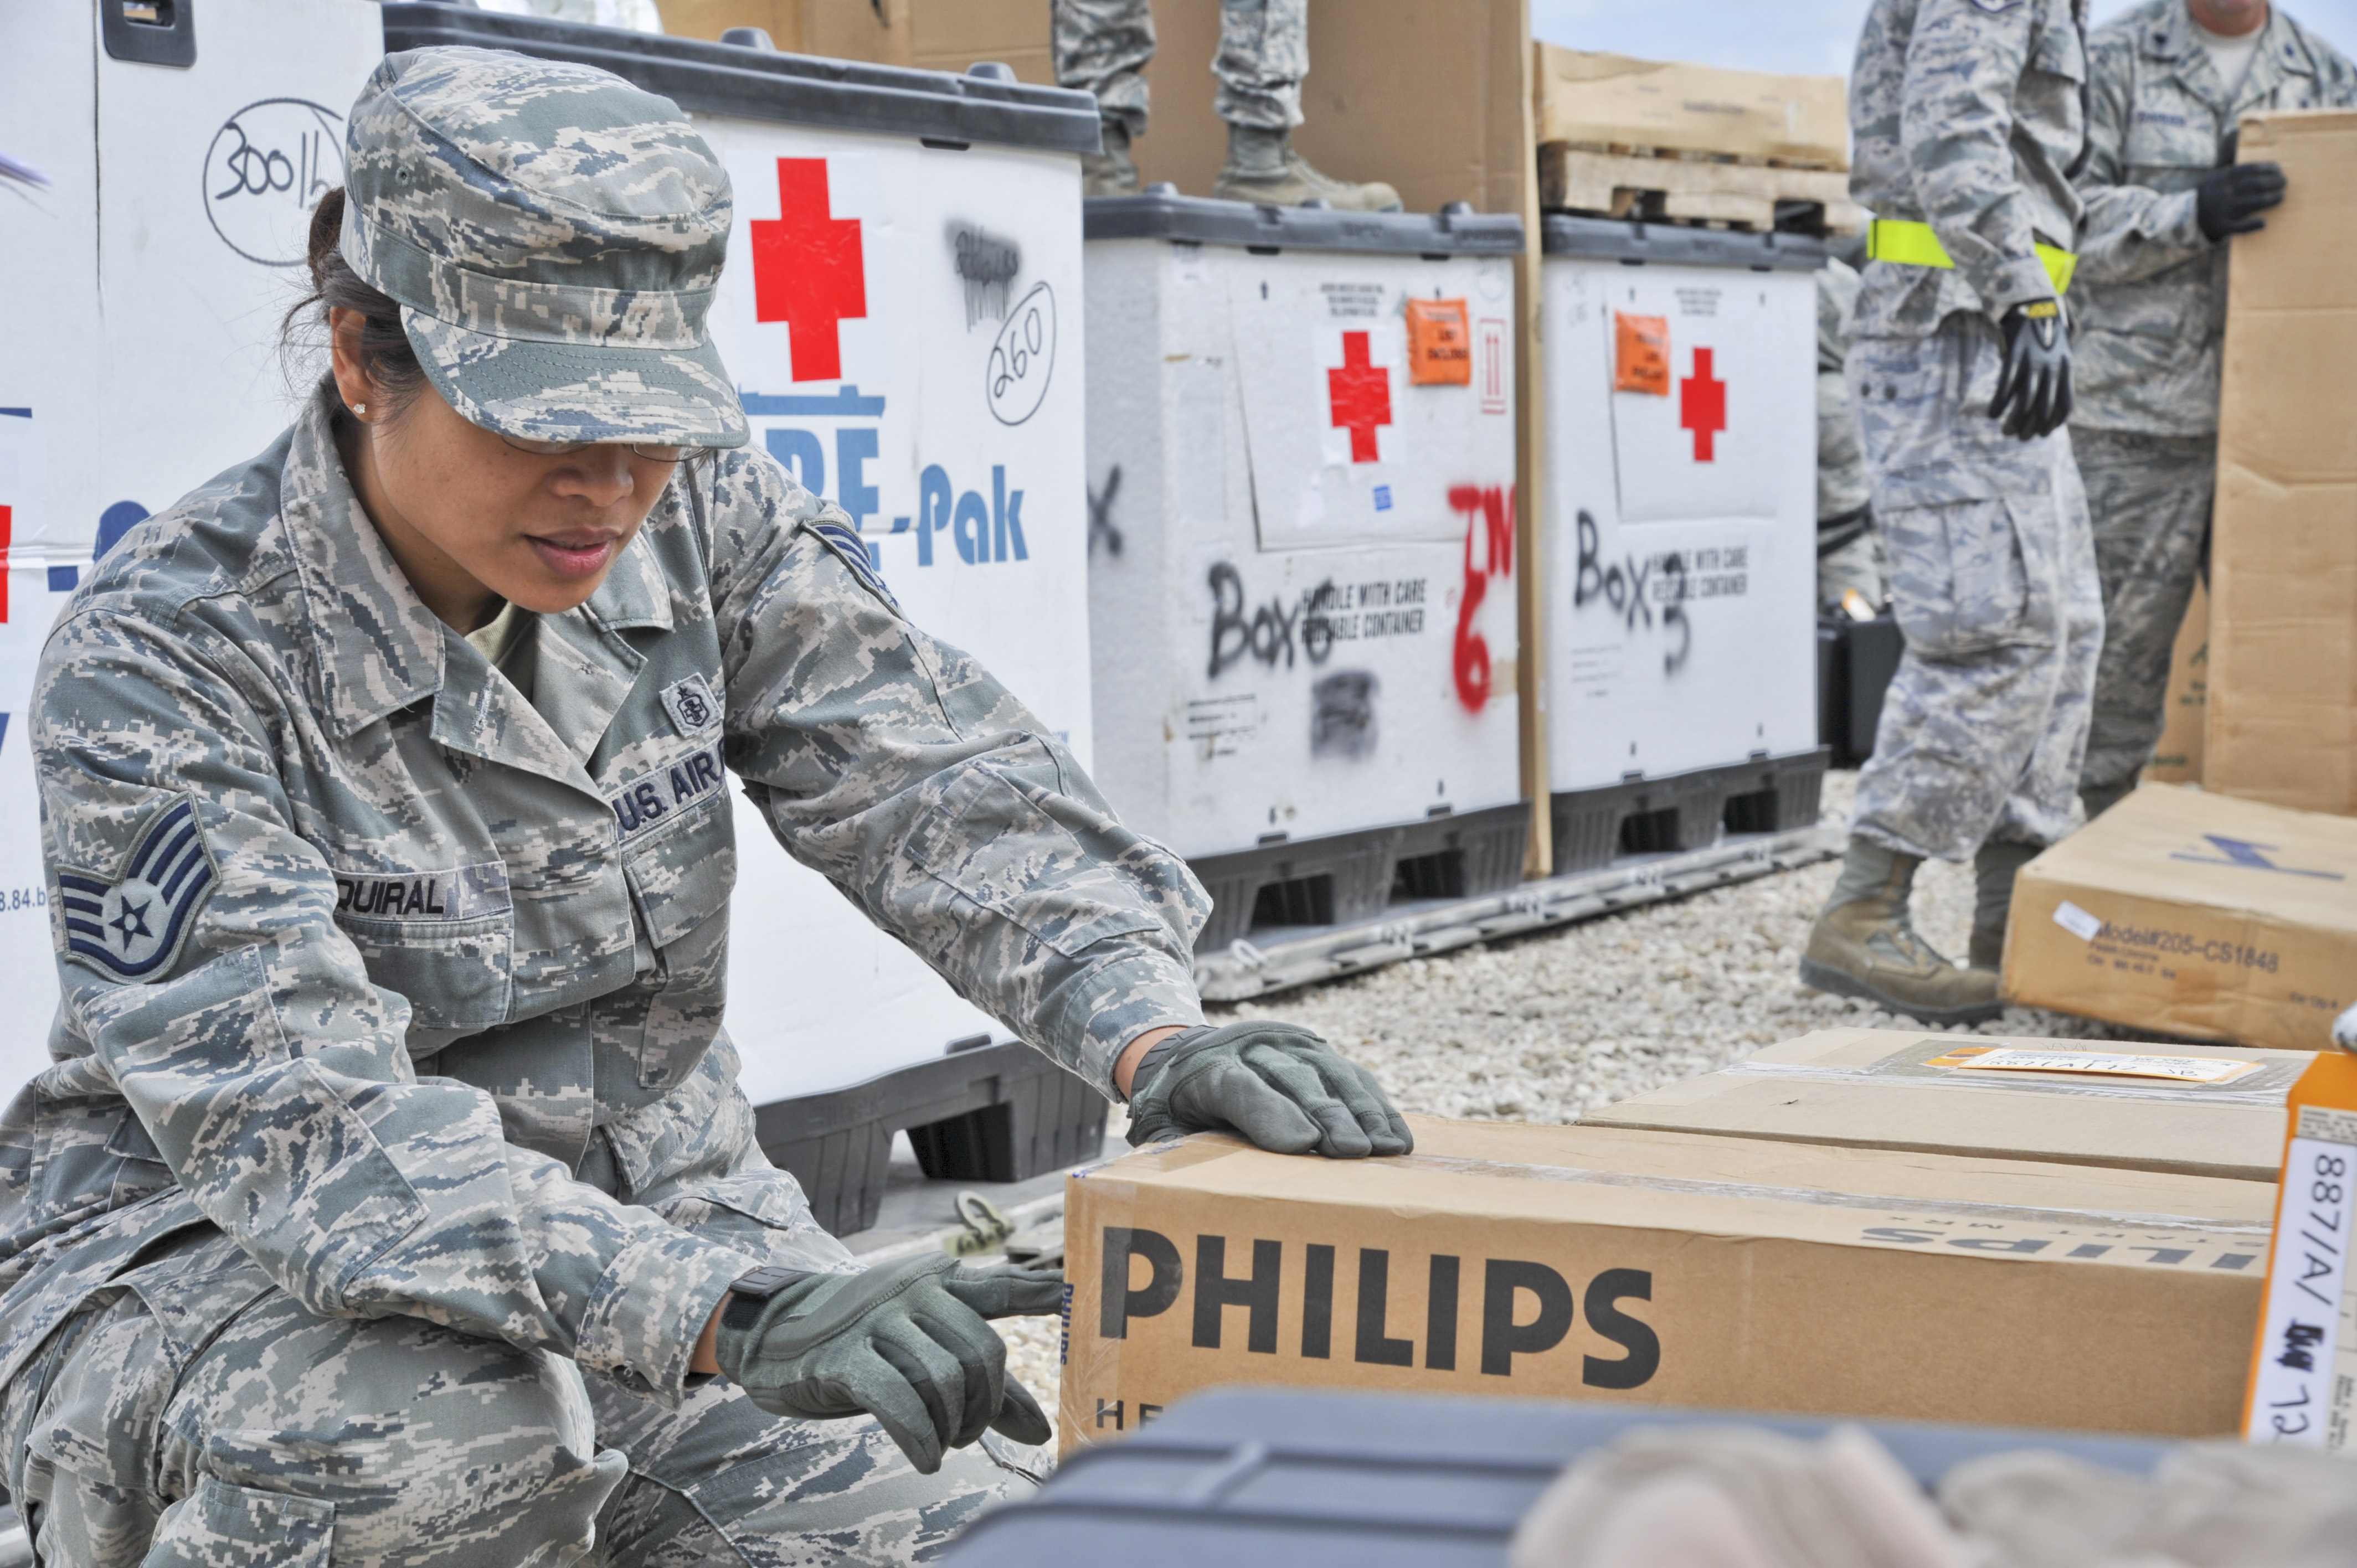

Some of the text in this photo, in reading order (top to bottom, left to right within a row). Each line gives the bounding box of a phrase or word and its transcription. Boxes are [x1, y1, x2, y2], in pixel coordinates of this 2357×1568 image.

[994, 308, 1042, 399] 260
[1360, 581, 1391, 608] WITH
[1394, 578, 1427, 605] CARE
[1363, 608, 1424, 639] CONTAINER
[612, 782, 668, 831] U.S.
[670, 751, 719, 804] AIR
[1099, 1226, 1661, 1390] PHILIPS
